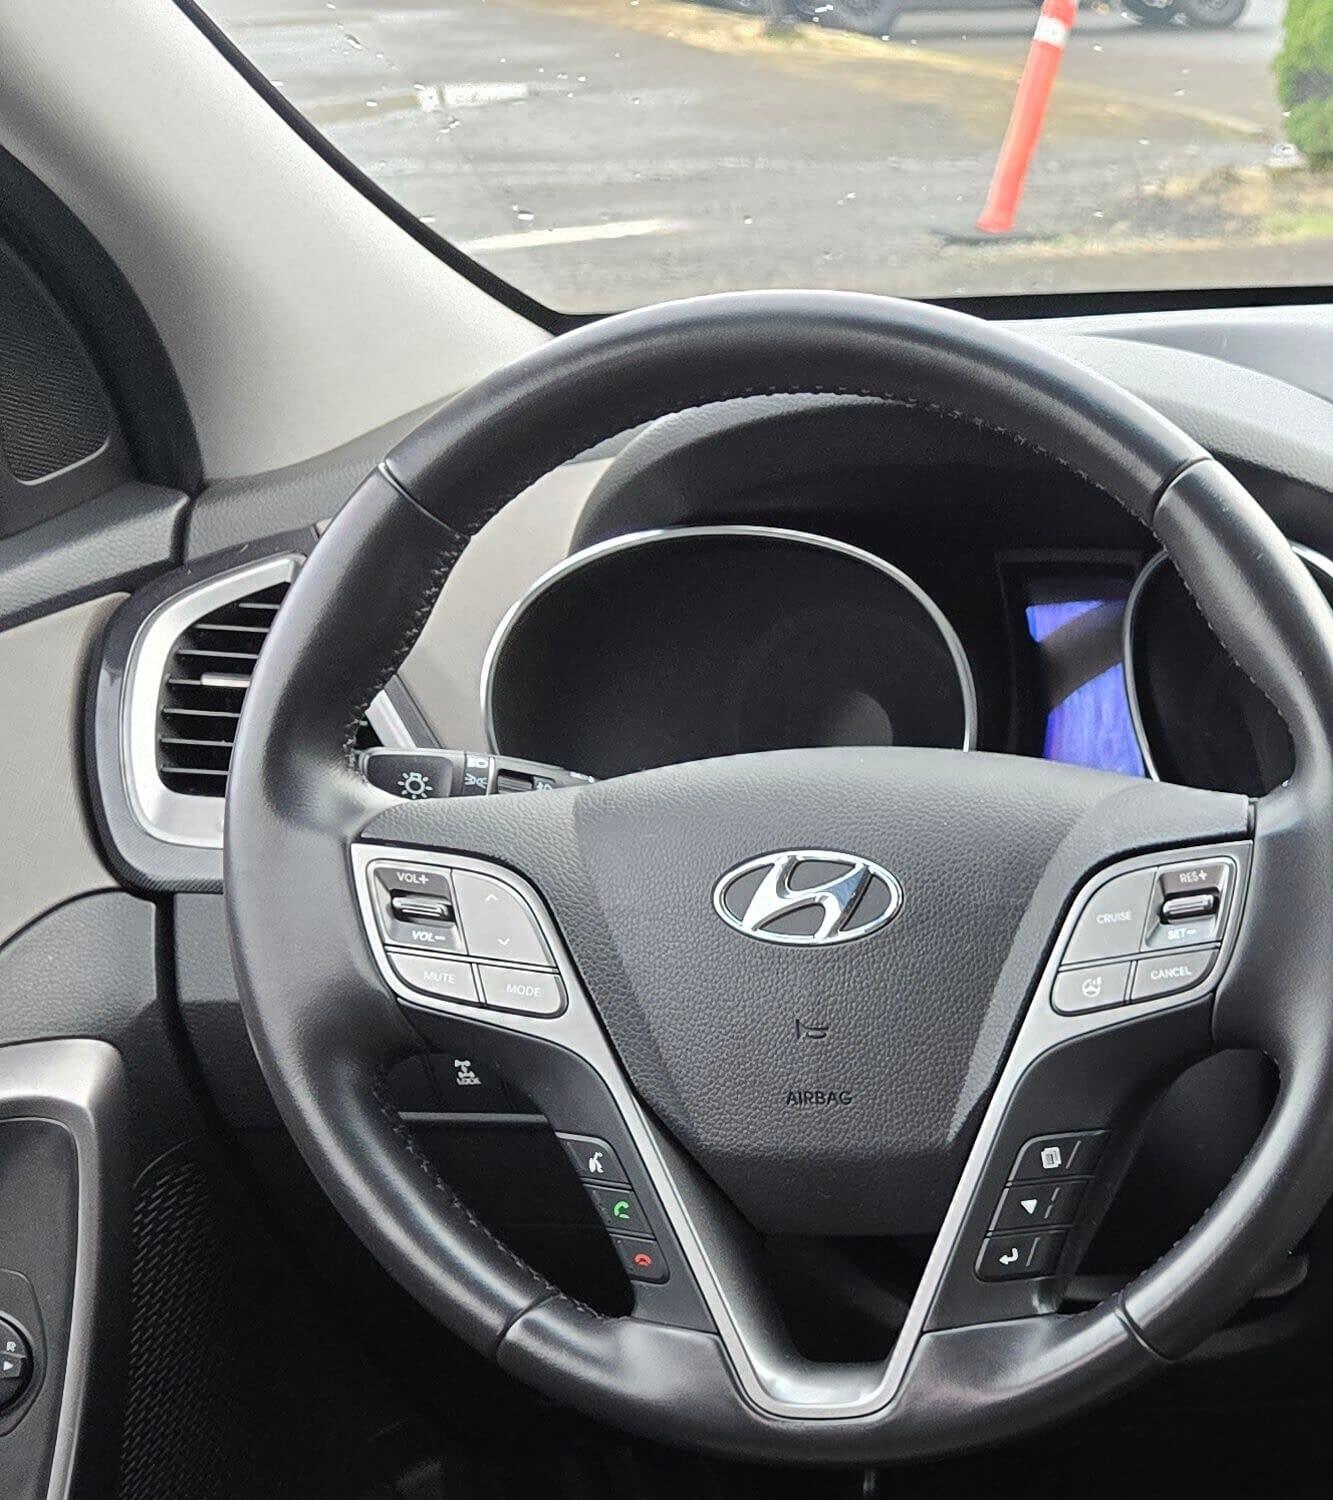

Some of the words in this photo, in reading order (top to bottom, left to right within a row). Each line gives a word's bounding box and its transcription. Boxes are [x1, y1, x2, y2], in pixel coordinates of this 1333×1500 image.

[1096, 910, 1132, 924] CRUISE
[423, 970, 457, 985] MUTE
[1150, 967, 1193, 980] CANCEL
[506, 983, 542, 998] MODE
[786, 1090, 853, 1106] AIRBAG
